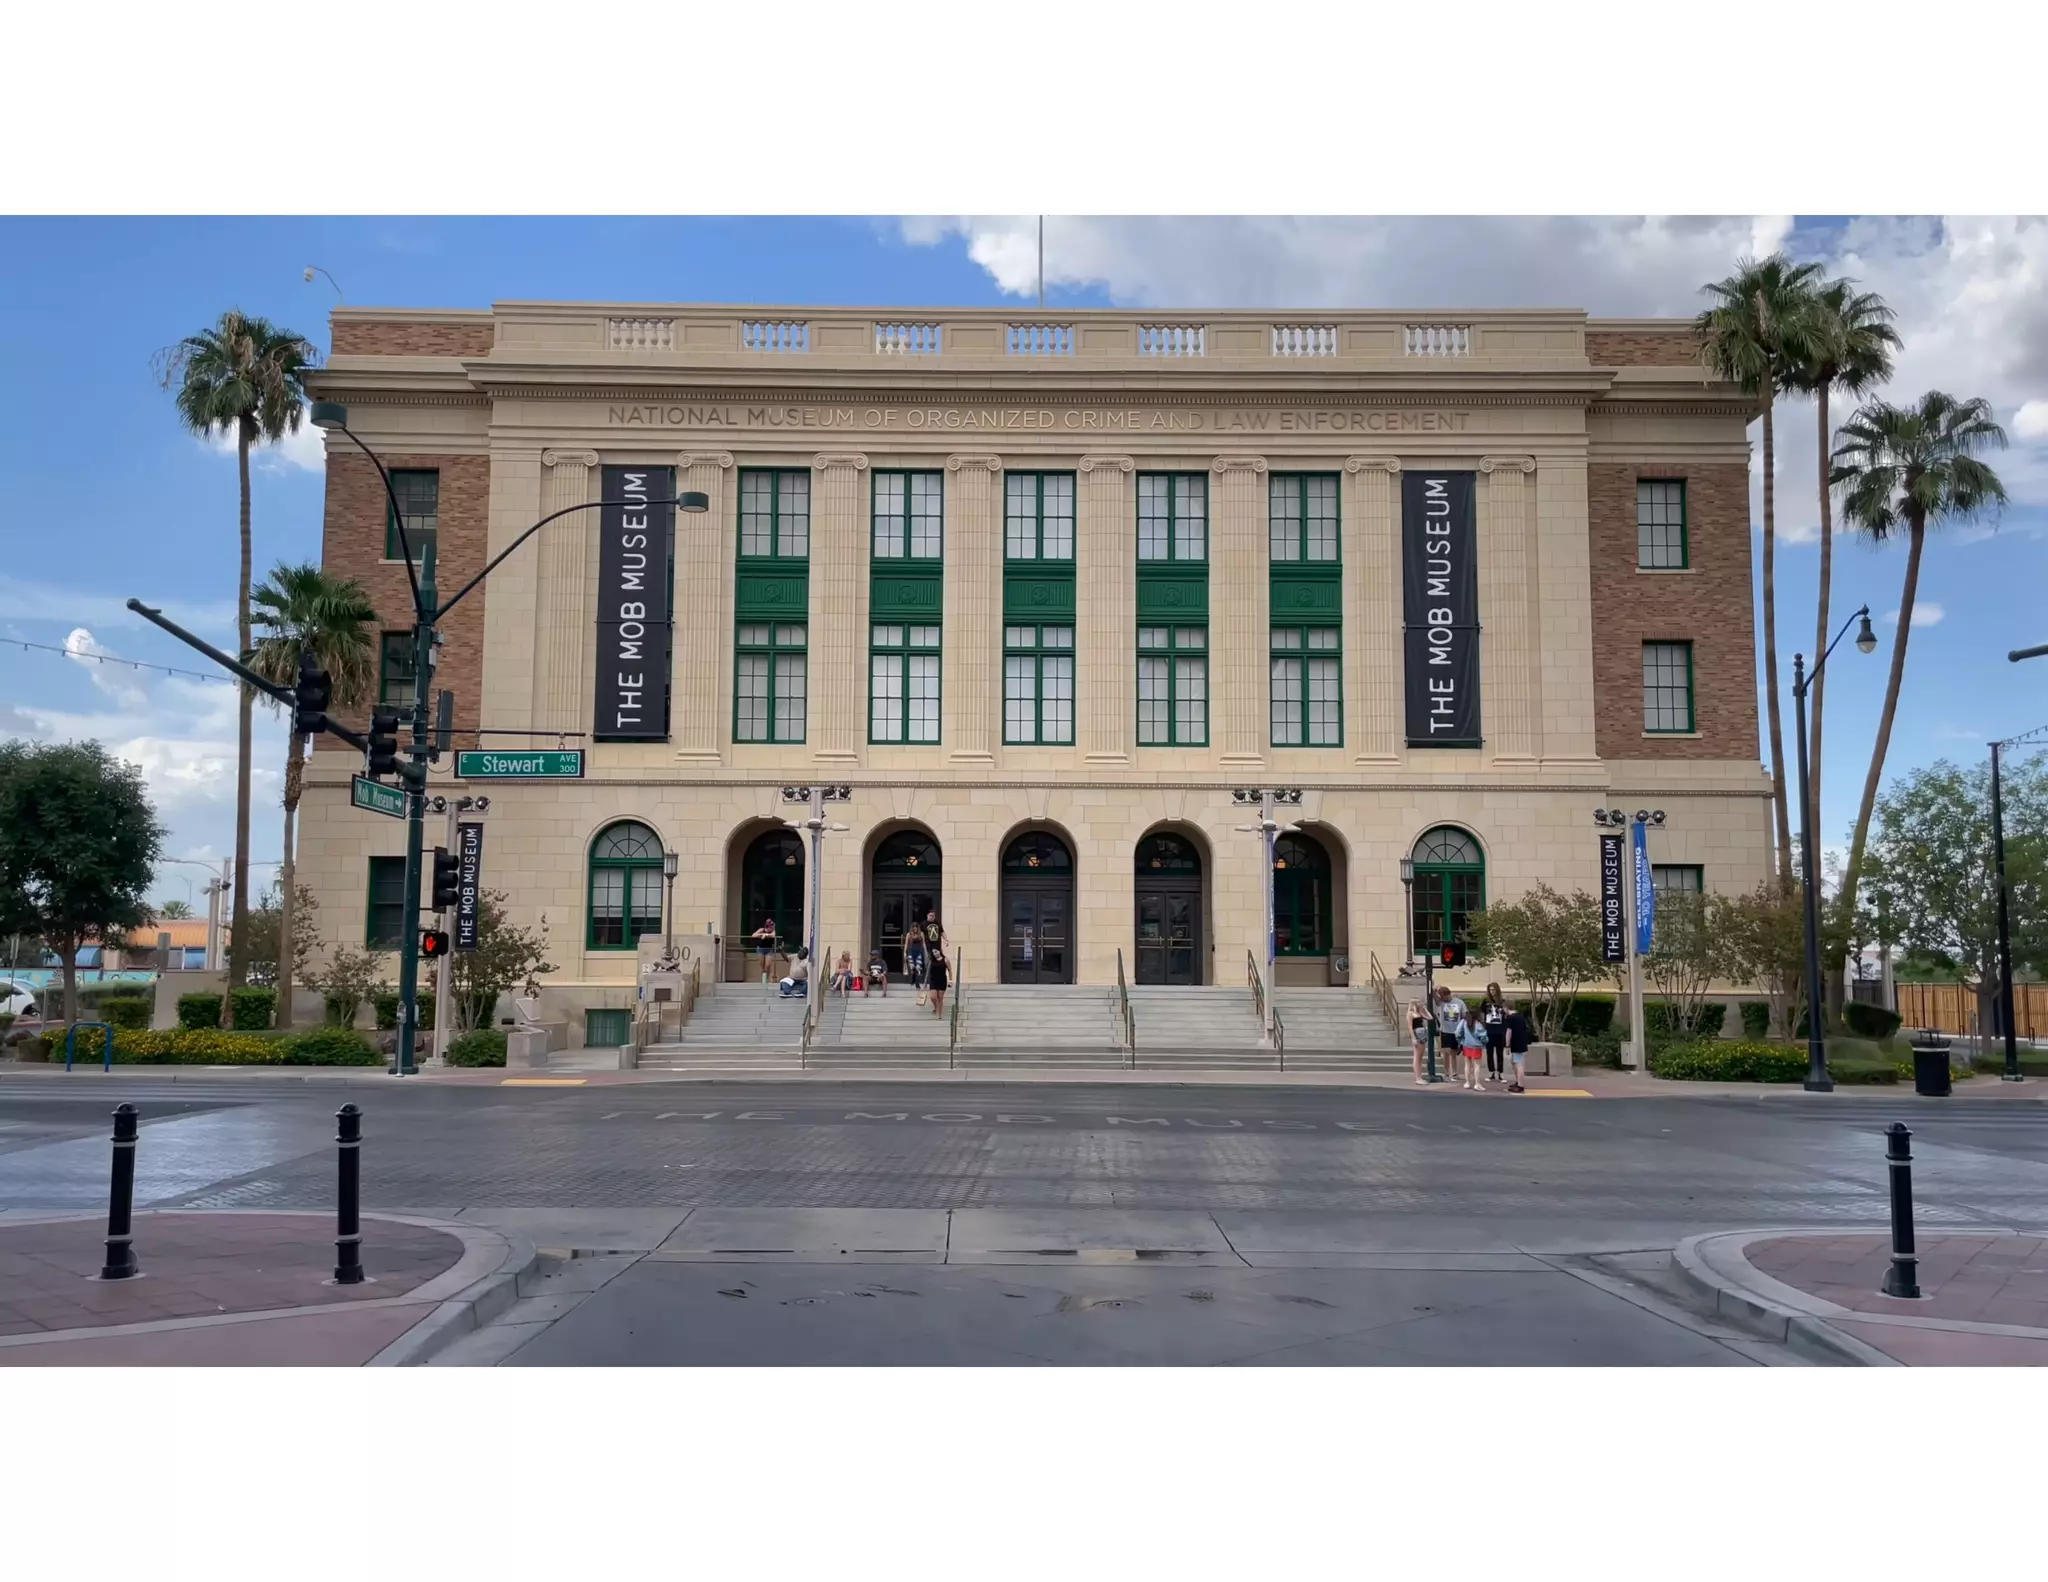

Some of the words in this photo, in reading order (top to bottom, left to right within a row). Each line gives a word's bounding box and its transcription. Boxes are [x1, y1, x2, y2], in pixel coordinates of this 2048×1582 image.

[608, 406, 738, 426] NATIONAL
[747, 407, 855, 427] MUSEUM
[864, 408, 898, 427] OF
[907, 409, 1055, 429] ORGANIZED
[1064, 410, 1141, 429] CRIME
[1150, 411, 1205, 430] AND
[1213, 411, 1271, 430] LAW
[1280, 412, 1470, 431] ENFORCEMENT
[621, 473, 648, 590] MUSEUM
[1425, 479, 1452, 596] MUSEUM
[619, 601, 646, 660] MOB
[1427, 607, 1453, 665] MOB
[617, 672, 644, 728] THE
[1429, 677, 1455, 734] THE
[462, 755, 468, 763] E
[482, 755, 545, 773] Stewart
[559, 754, 577, 762] AVE
[559, 765, 576, 773] 300
[463, 828, 477, 884] MUSEUM
[1605, 839, 1618, 895] MUSEUM
[462, 886, 475, 914] MOB
[1606, 898, 1619, 927] MOB
[460, 918, 473, 945] THE
[1607, 931, 1620, 958] THE
[599, 1111, 795, 1120] THE
[843, 1111, 1058, 1124] MOB
